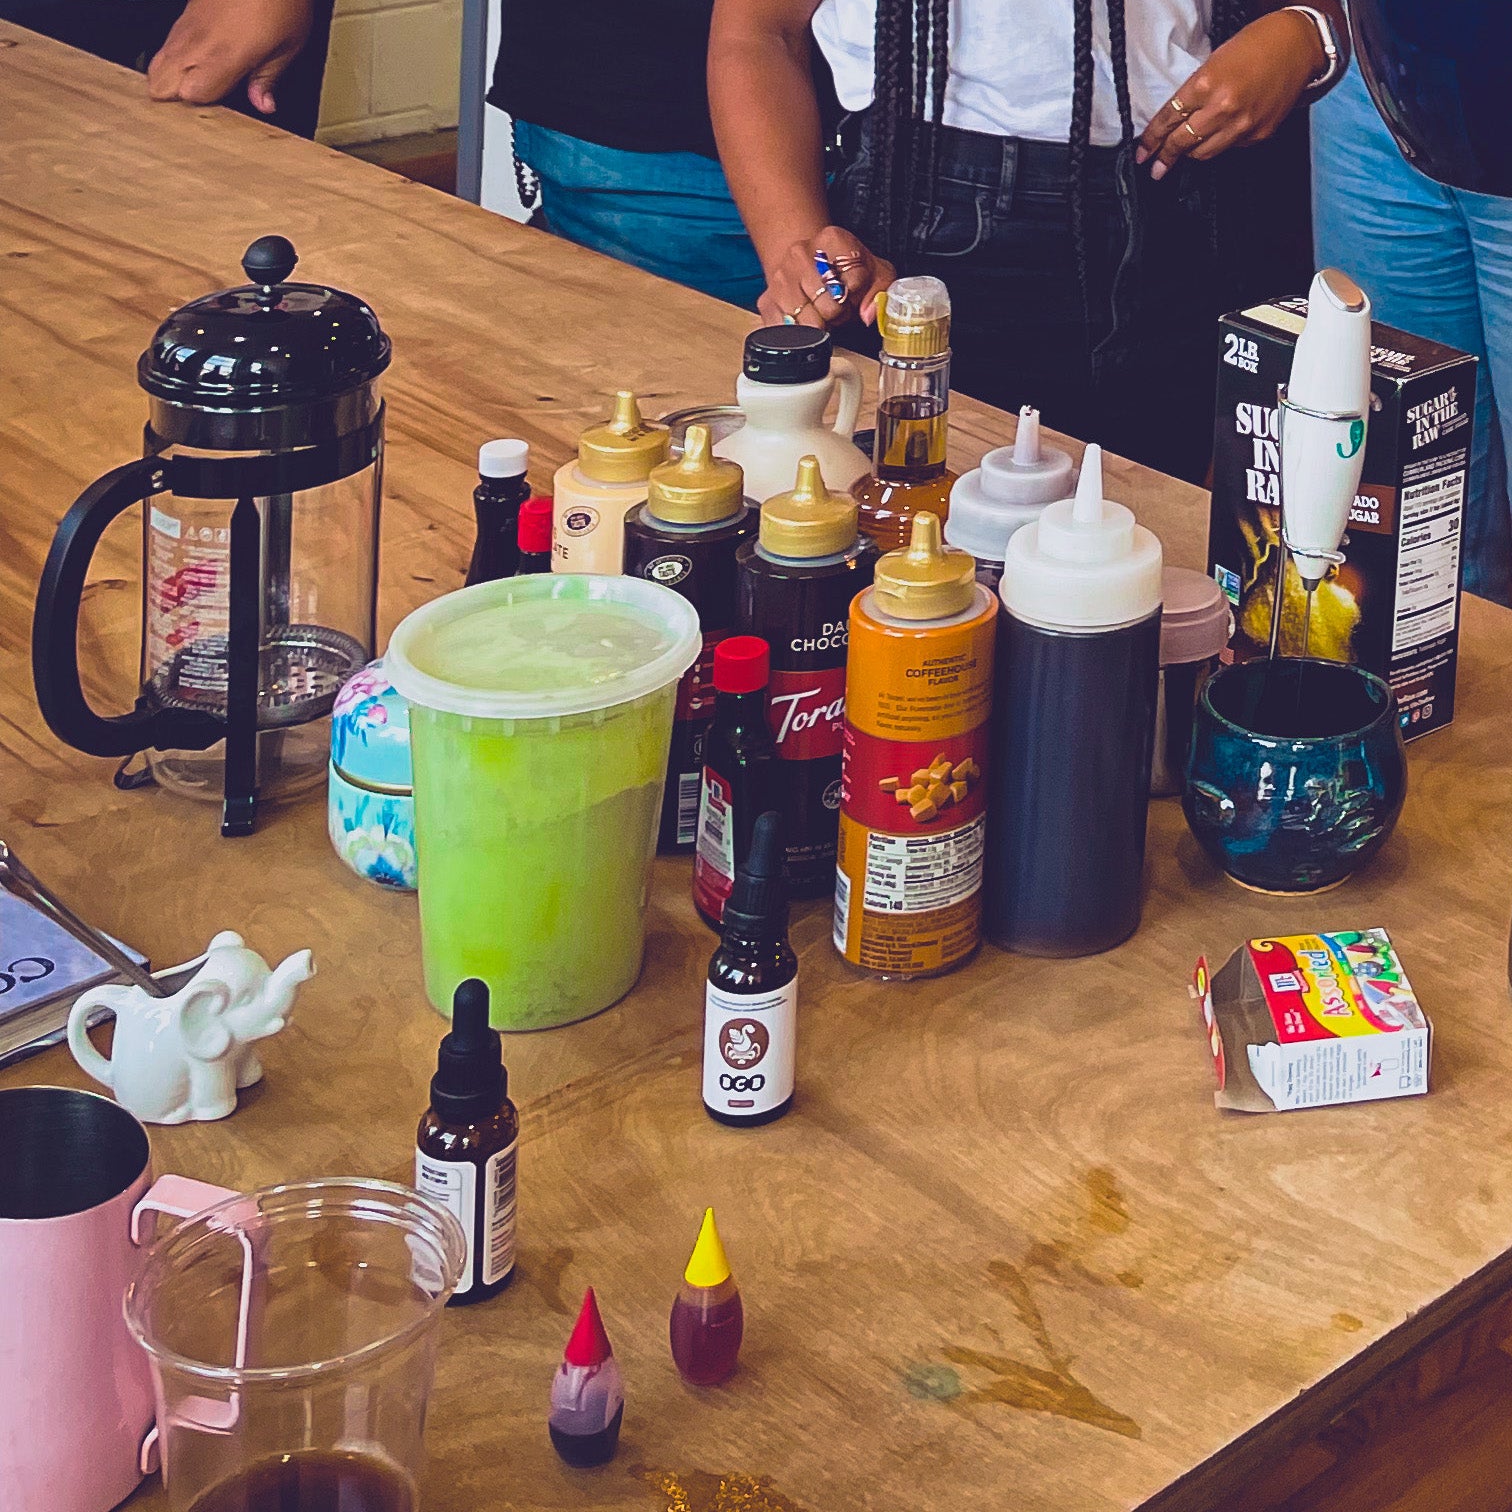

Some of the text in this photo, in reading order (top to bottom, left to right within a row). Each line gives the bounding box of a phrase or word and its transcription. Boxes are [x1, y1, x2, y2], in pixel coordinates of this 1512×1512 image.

[1223, 333, 1239, 366] 2
[1237, 356, 1258, 374] BOX
[1406, 392, 1449, 424] SUGAR
[1416, 416, 1431, 434] IN
[1432, 401, 1459, 426] THE
[1412, 424, 1440, 450] RAW
[1245, 469, 1281, 506] RA
[822, 620, 850, 636] DA
[905, 658, 977, 678] COFFEEHOUSE
[771, 687, 846, 744] Tora
[1297, 949, 1353, 1018] Assorted
